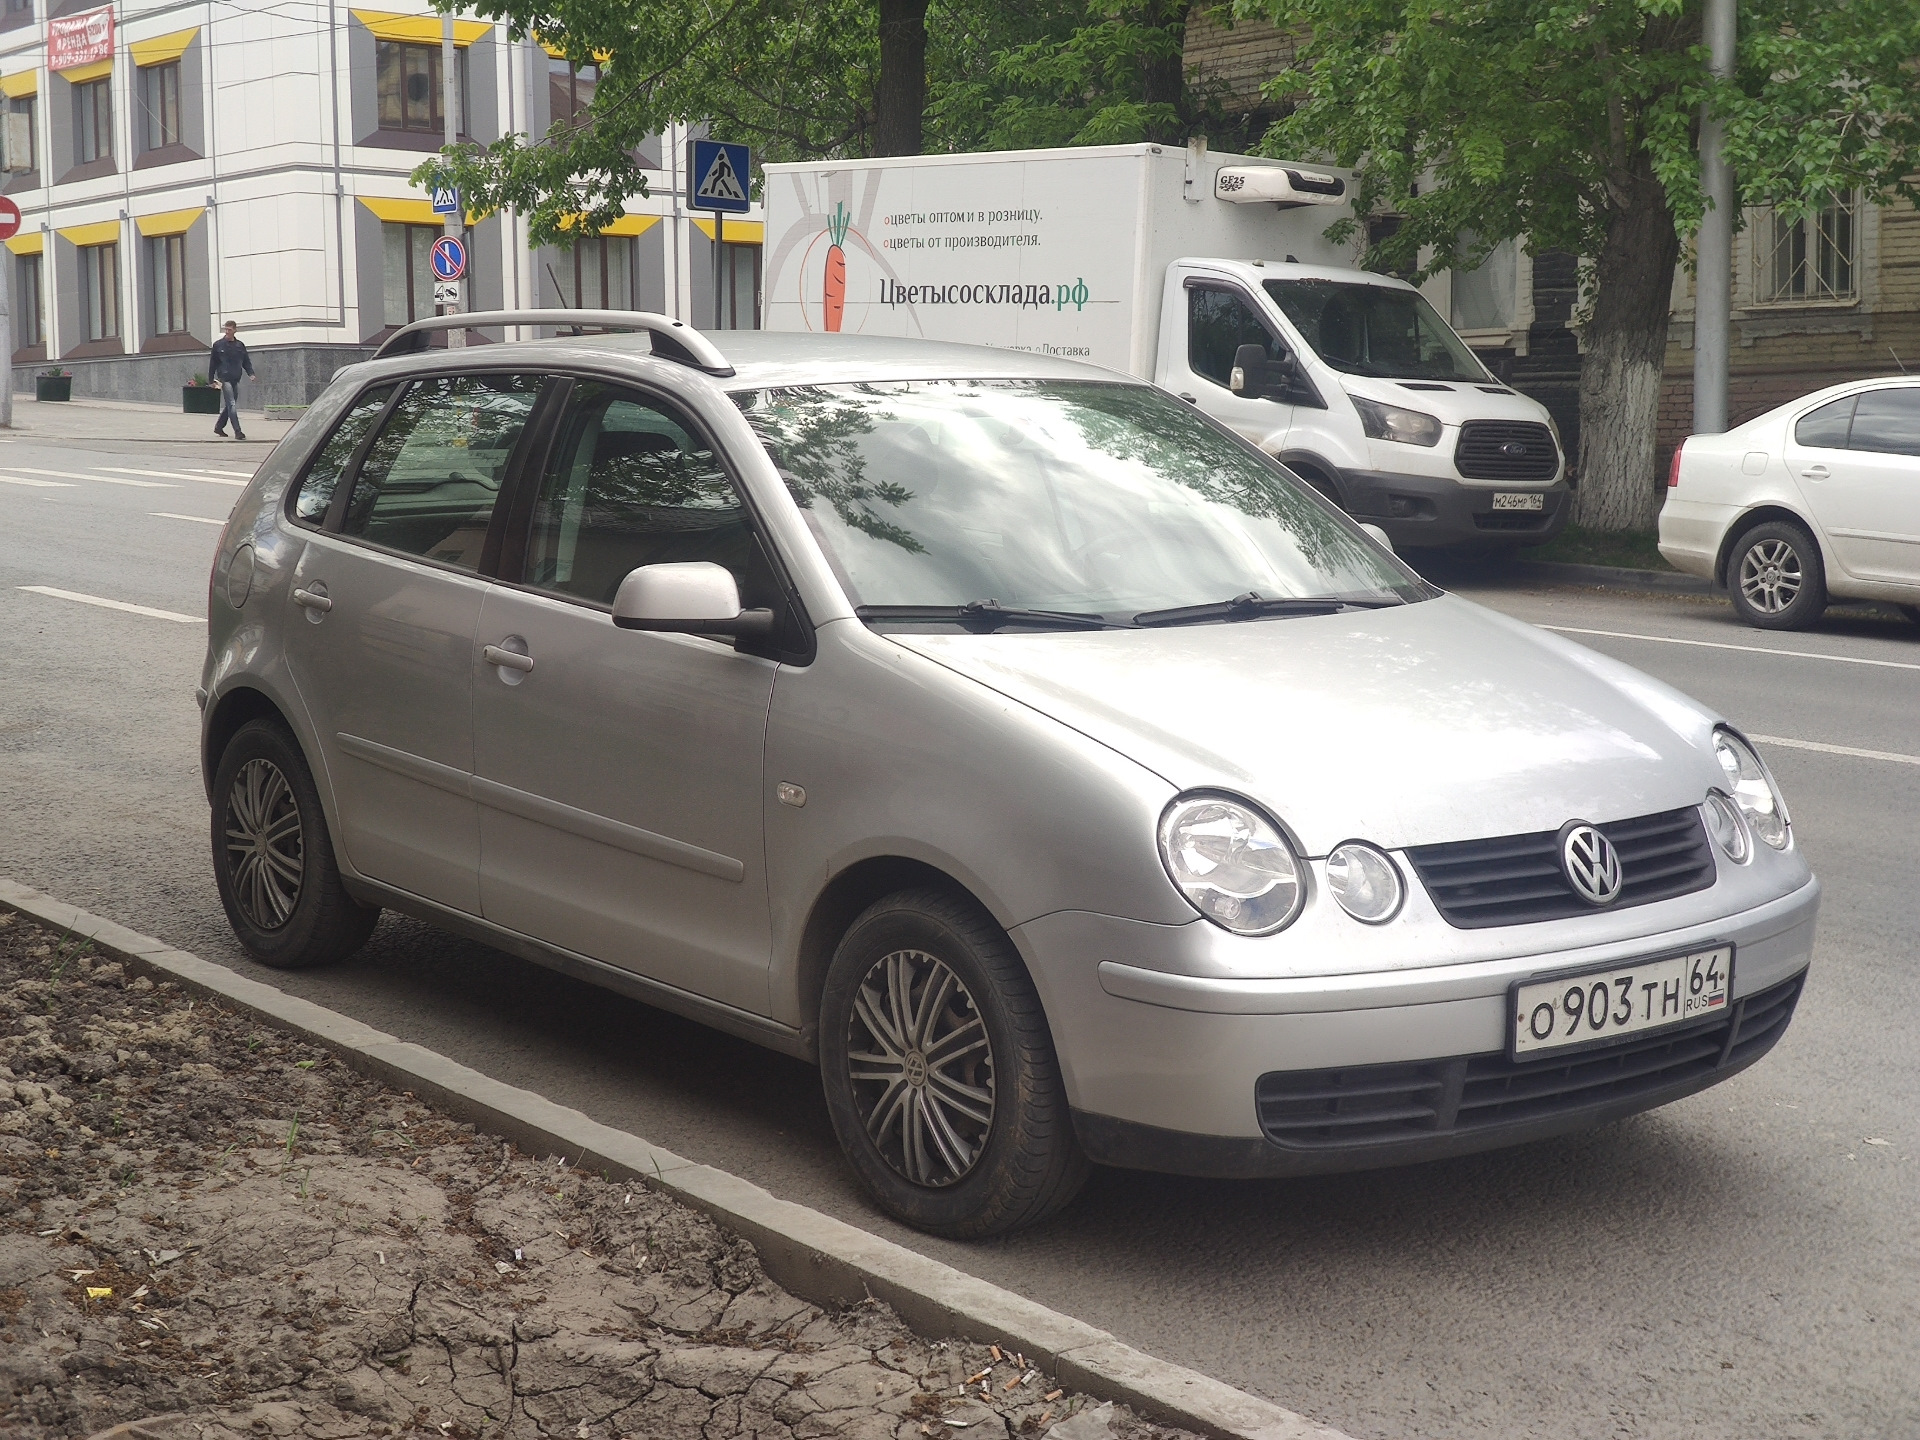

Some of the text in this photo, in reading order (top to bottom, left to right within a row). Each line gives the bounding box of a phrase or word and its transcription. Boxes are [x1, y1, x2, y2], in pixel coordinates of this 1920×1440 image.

[57, 33, 88, 51] АРЕНДА
[929, 209, 964, 223] оптом
[966, 209, 974, 222] и
[978, 210, 985, 221] в
[988, 208, 1043, 225] розницу.
[928, 236, 942, 248] от
[945, 233, 1041, 250] производителя.
[880, 277, 1089, 311] Цветысосклада.рф
[1689, 954, 1719, 995] 64
[1685, 994, 1709, 1012] RUS
